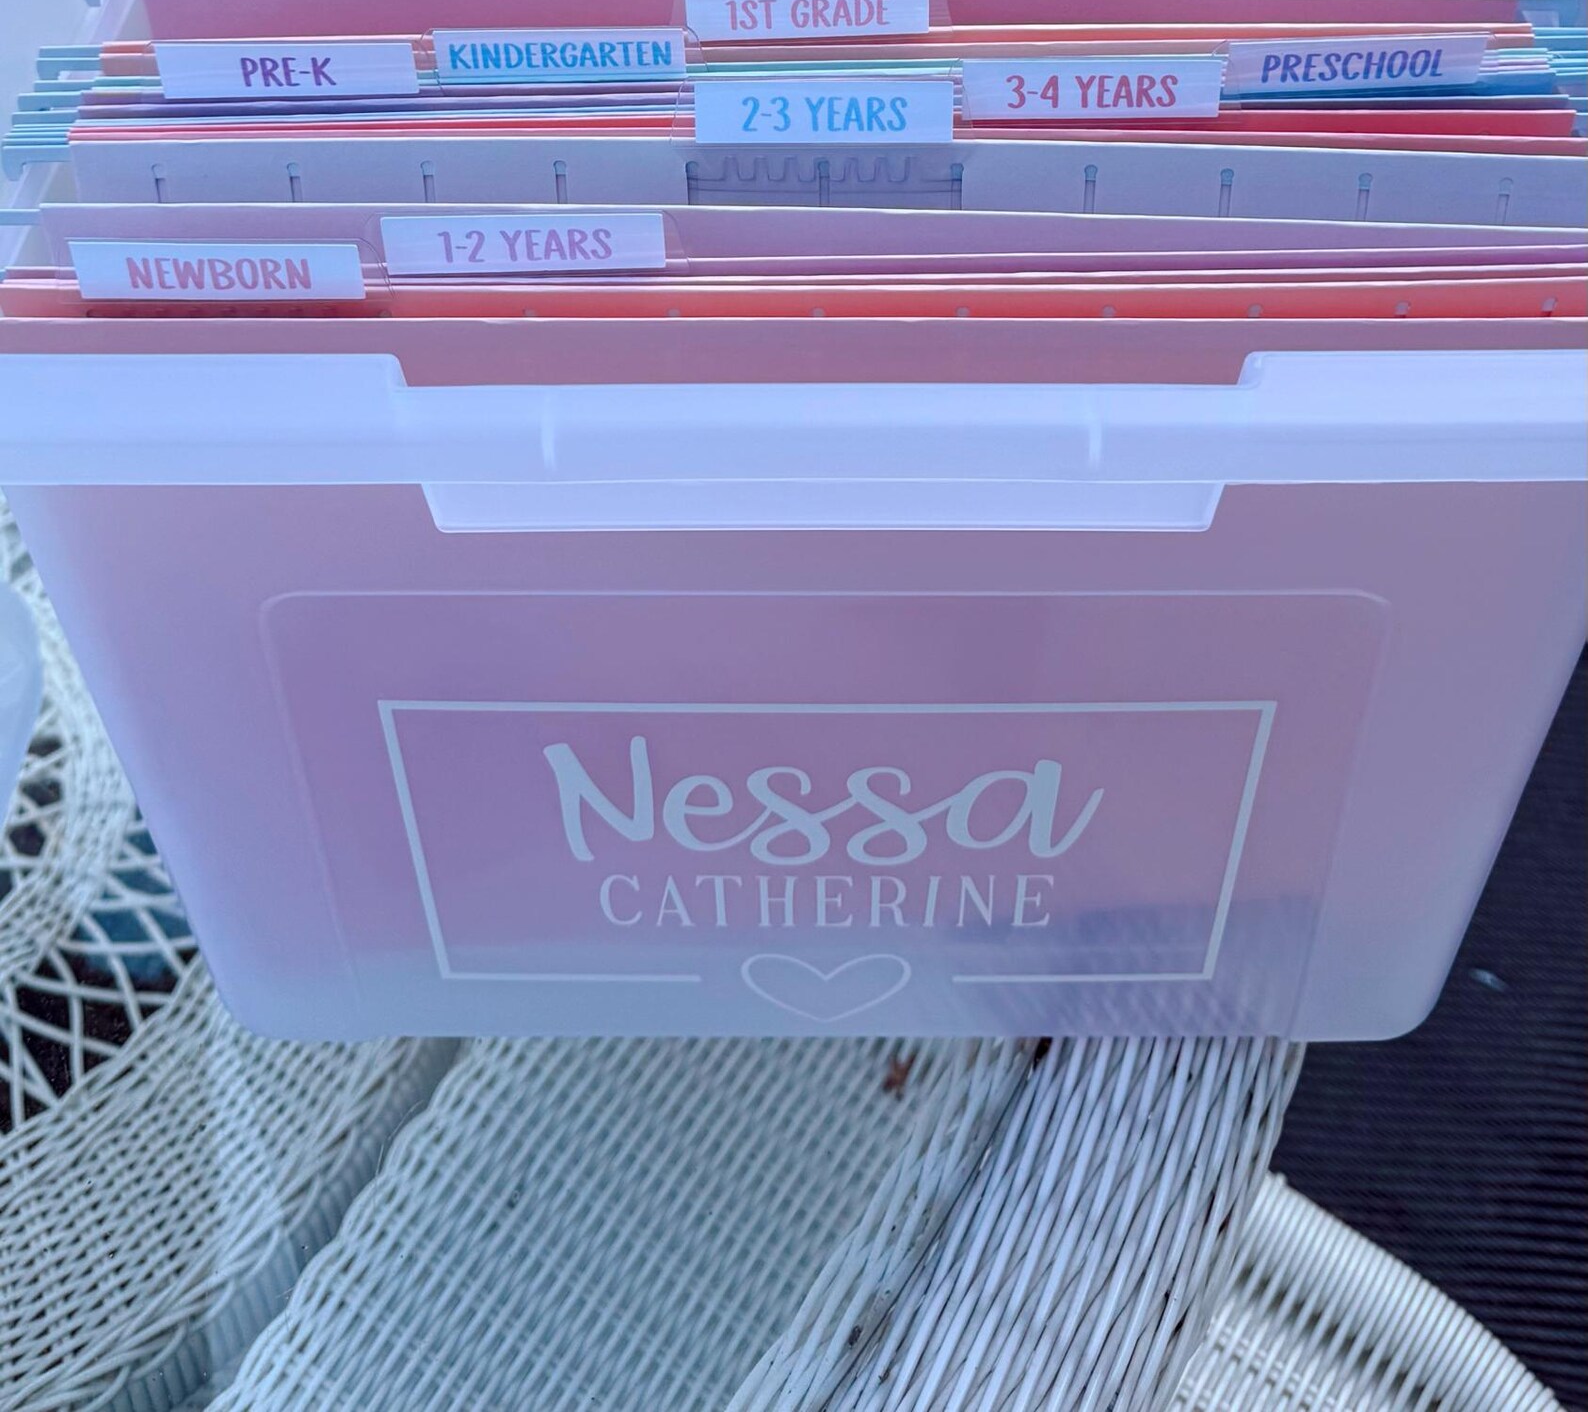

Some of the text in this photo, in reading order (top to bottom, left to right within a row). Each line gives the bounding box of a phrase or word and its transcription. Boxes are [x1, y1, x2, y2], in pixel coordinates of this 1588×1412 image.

[240, 56, 337, 88] PRE-K
[448, 40, 673, 70] KINDERGARTEN
[1261, 48, 1444, 84] PRESCHOOL
[1006, 74, 1179, 109] 3-4 YEARS
[741, 96, 908, 132] 2-3 YEARS
[437, 228, 613, 264] 1-2 YEARS
[126, 257, 313, 290] NEWBORN
[543, 735, 1104, 866] Nessa
[599, 874, 1055, 929] CATHERINE
